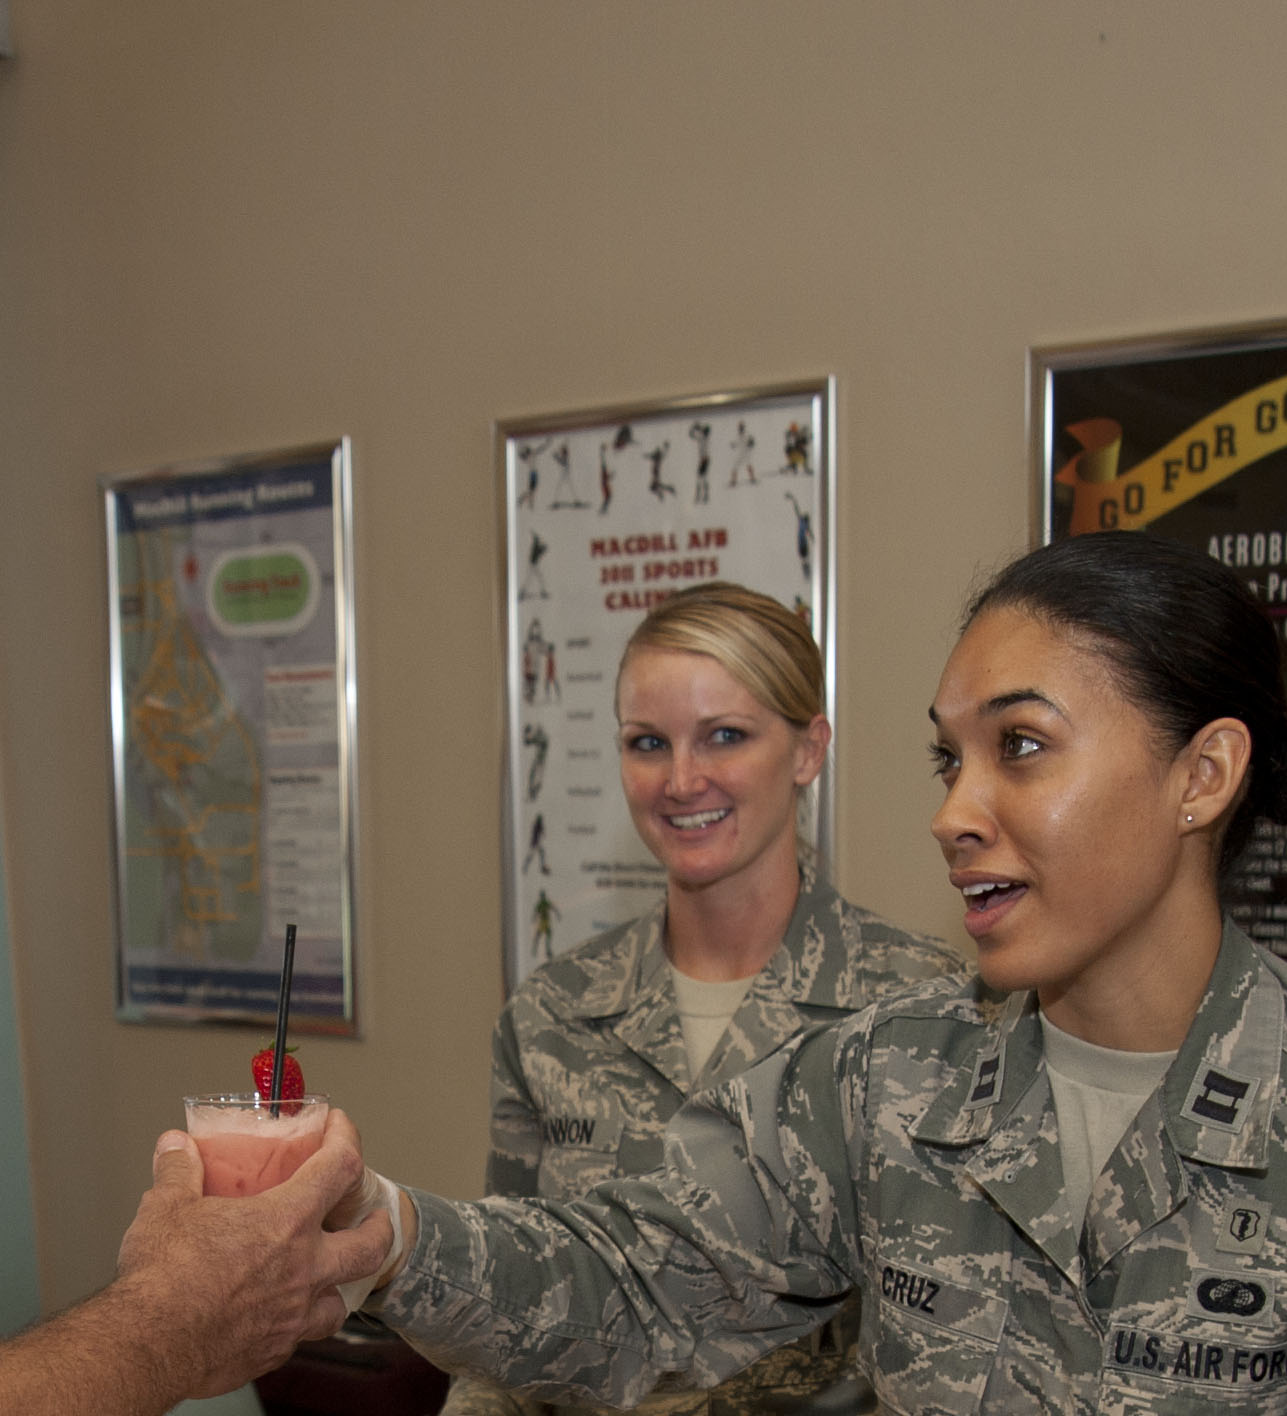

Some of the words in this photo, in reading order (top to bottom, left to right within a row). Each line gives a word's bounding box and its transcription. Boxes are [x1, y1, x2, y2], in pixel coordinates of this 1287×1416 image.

[1099, 483, 1145, 530] GO
[1162, 424, 1237, 492] FOR
[590, 534, 677, 557] MACDILL
[688, 528, 728, 549] AFB
[643, 558, 719, 581] SPORTS
[881, 1265, 941, 1316] CRUZ
[1114, 1329, 1167, 1372] U.S.
[1173, 1339, 1223, 1381] AIR
